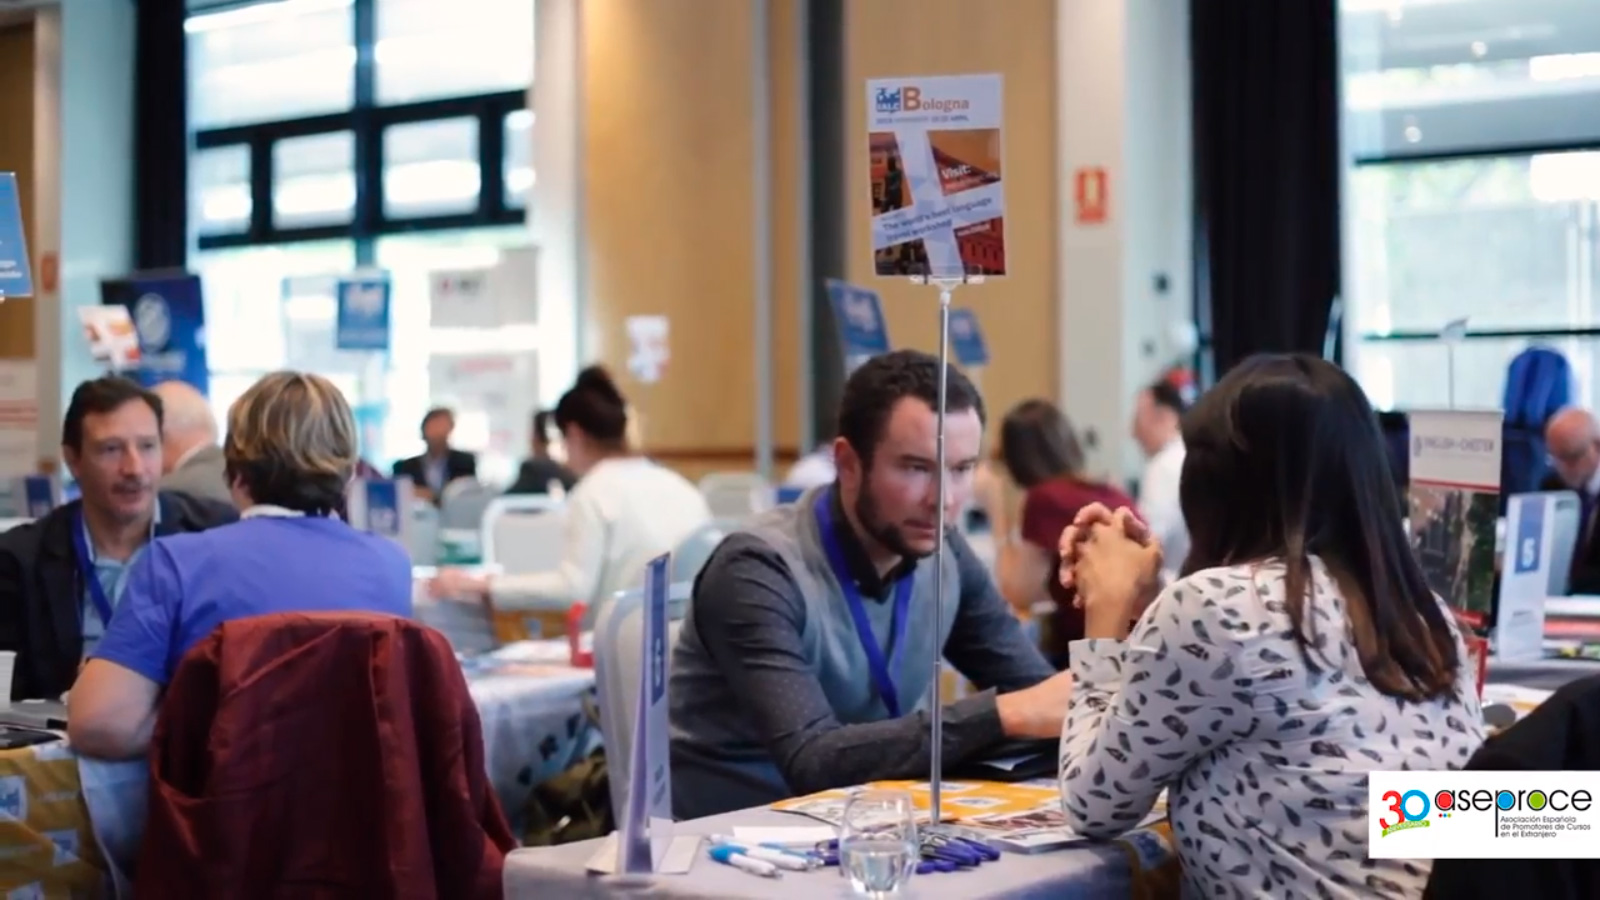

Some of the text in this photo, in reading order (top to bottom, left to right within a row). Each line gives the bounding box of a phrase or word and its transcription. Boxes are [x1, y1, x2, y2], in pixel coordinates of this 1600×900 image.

[903, 86, 970, 113] Bologna
[941, 164, 972, 179] Visit:
[882, 221, 899, 231] The
[952, 197, 993, 213] language
[912, 219, 953, 236] workshop
